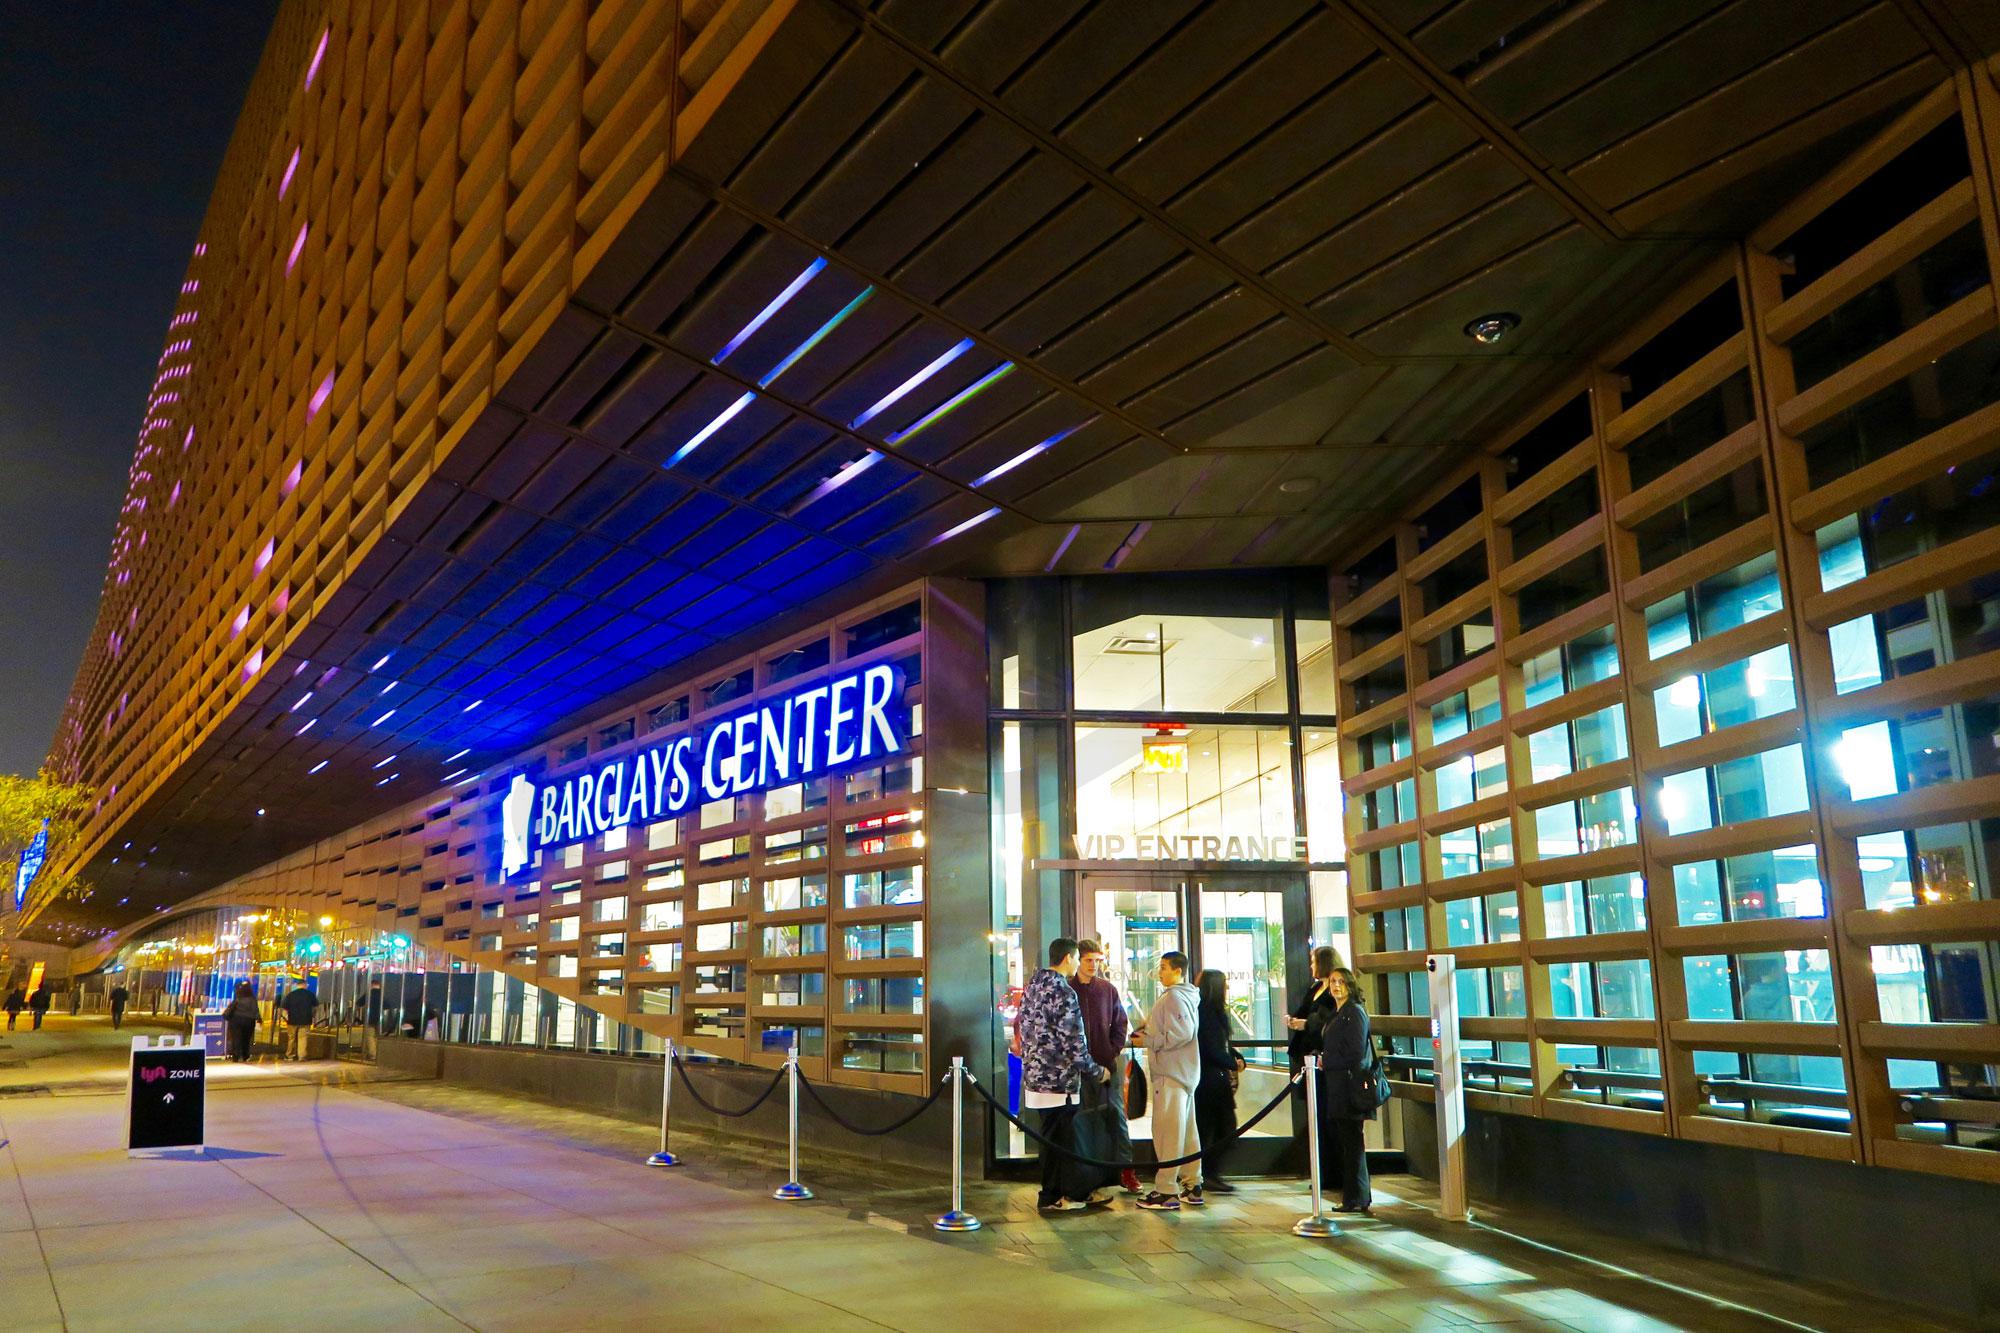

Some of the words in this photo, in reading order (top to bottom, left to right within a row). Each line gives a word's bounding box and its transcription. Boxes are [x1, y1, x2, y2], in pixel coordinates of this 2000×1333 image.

[540, 736, 693, 846] BARCLAYS
[703, 665, 900, 799] CENTER
[1072, 834, 1125, 860] VIP
[1136, 835, 1308, 862] ENTRANCE
[169, 1069, 200, 1079] ZONE
